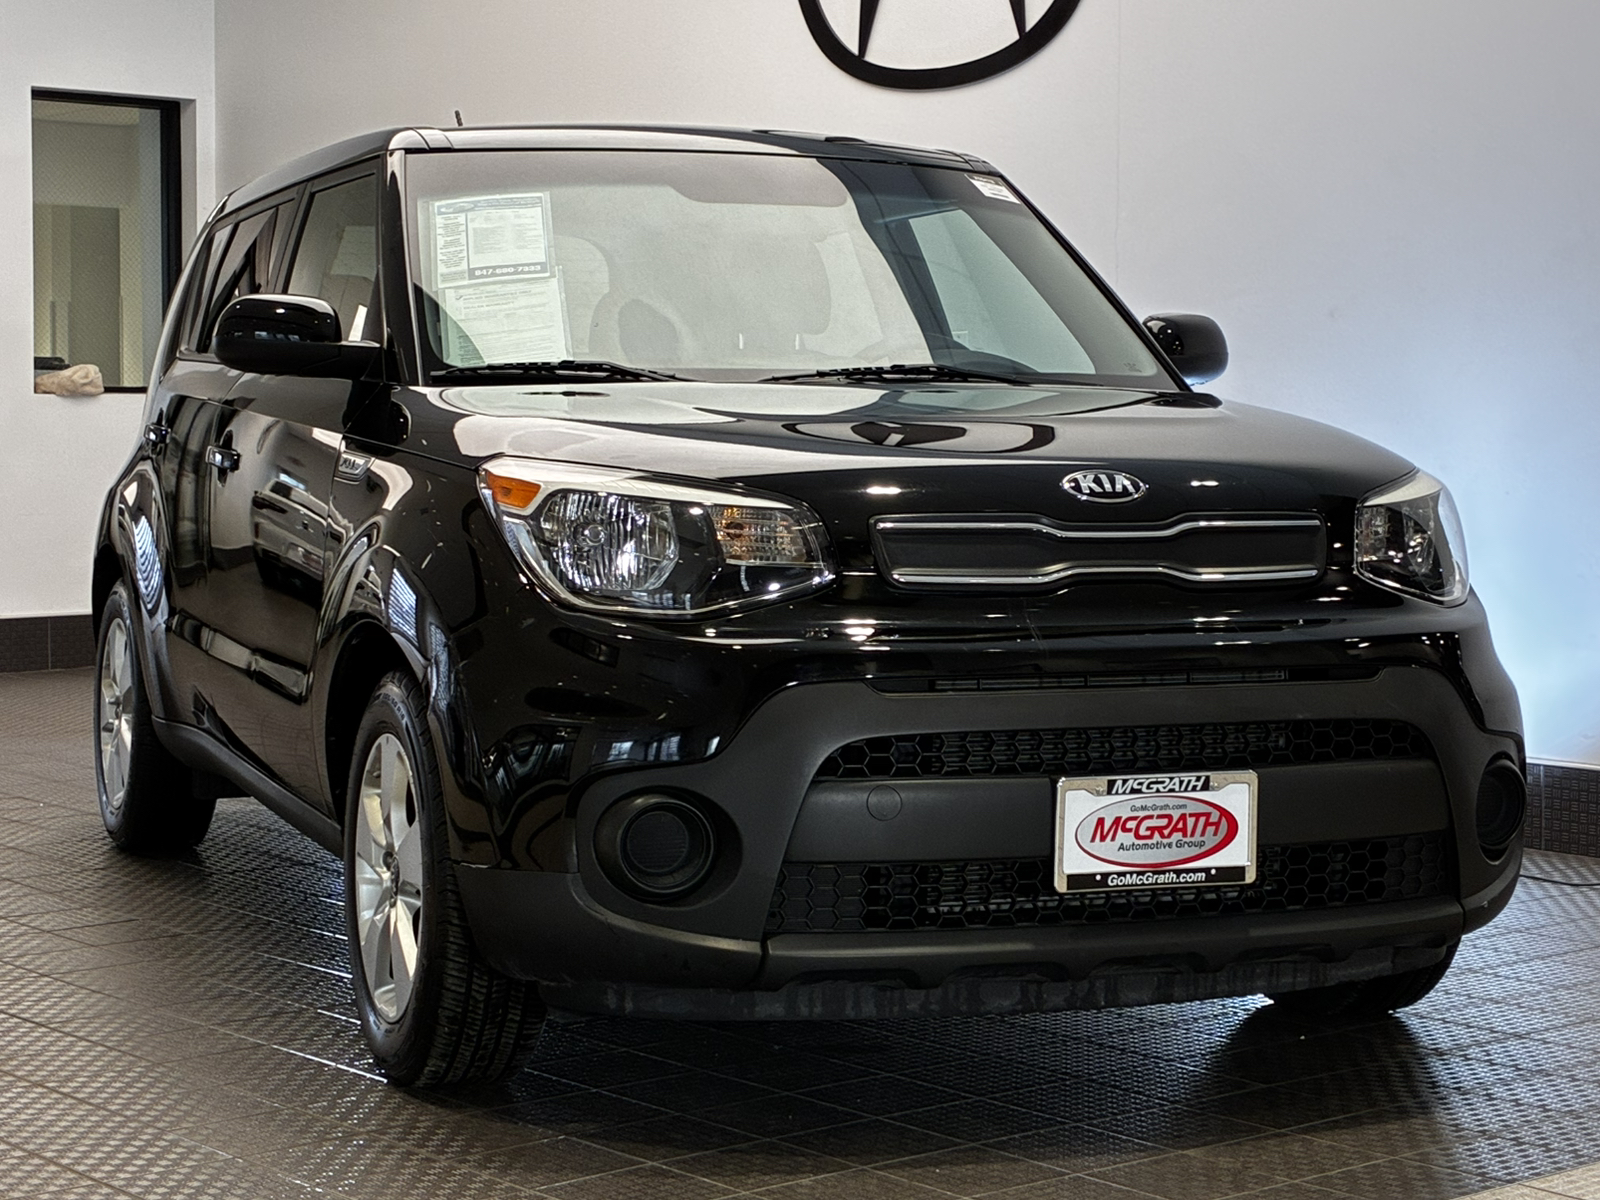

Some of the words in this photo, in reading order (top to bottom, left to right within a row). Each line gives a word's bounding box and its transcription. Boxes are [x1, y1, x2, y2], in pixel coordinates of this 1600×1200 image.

[1076, 473, 1136, 493] KIA
[1130, 803, 1188, 813] GoMcGrath.com
[1117, 840, 1173, 852] Automotive
[1175, 839, 1206, 850] Group
[1107, 871, 1206, 886] GoMcGrath.com
